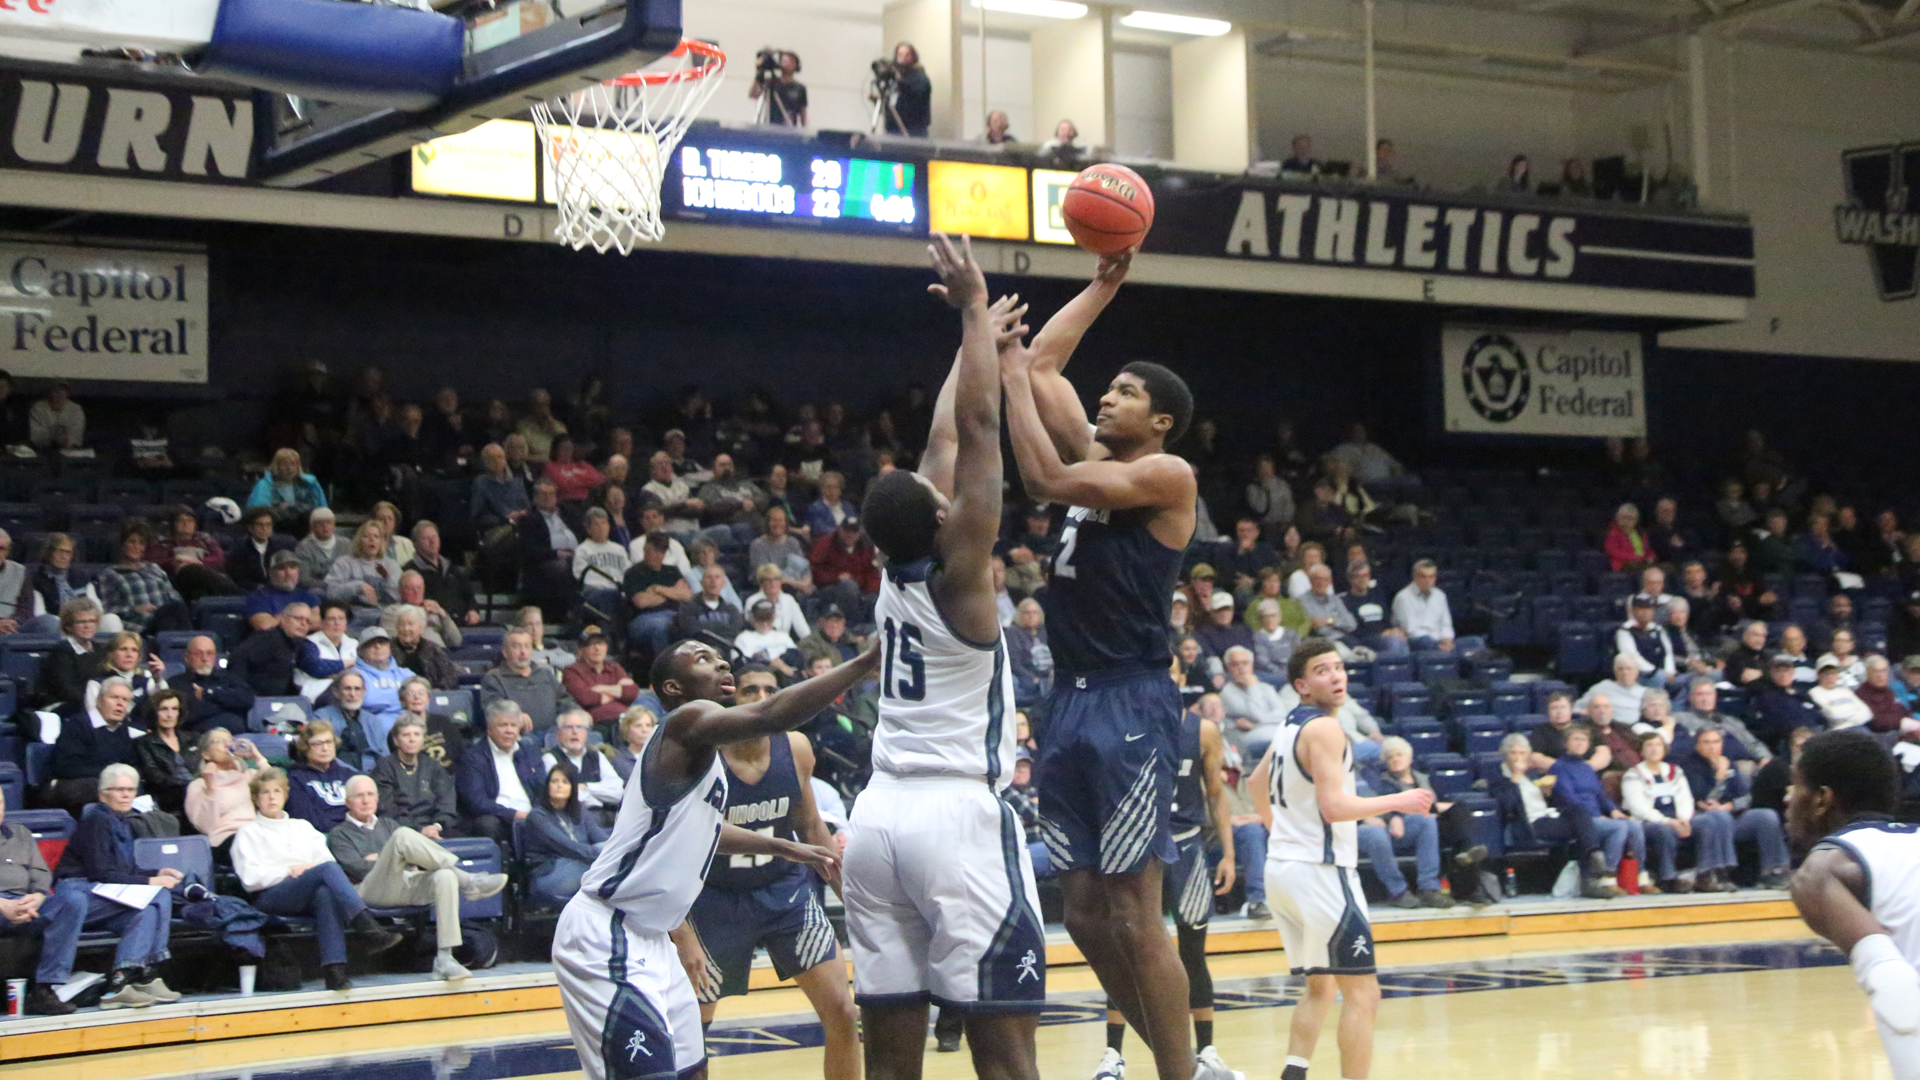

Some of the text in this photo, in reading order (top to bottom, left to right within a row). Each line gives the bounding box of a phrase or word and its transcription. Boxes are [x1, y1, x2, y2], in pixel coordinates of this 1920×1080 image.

[504, 214, 523, 238] D
[1225, 189, 1577, 279] ATHLETICS
[11, 255, 188, 307] Capitol
[1015, 251, 1031, 274] D
[1422, 278, 1436, 301] E
[12, 311, 189, 356] Federal
[1536, 343, 1633, 383] Capitol
[1538, 384, 1635, 418] Federal
[883, 616, 927, 702] 15
